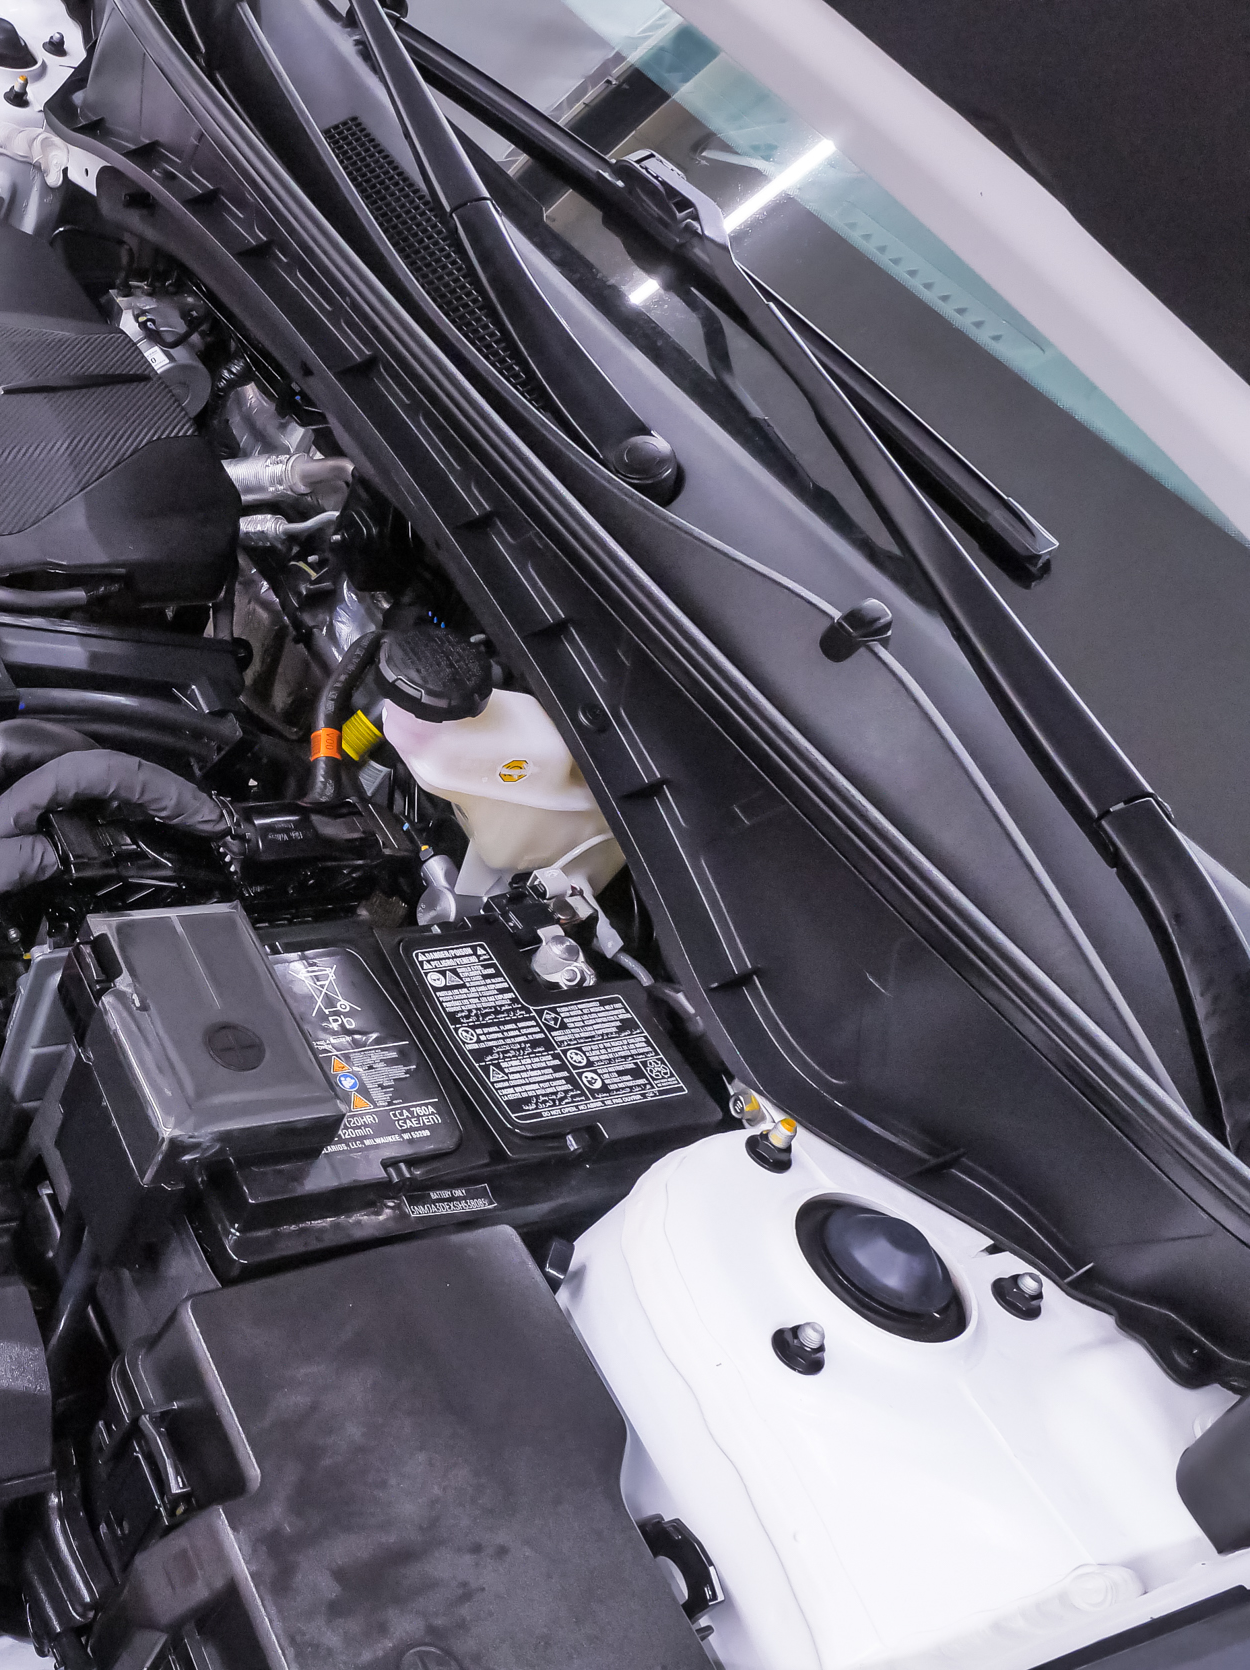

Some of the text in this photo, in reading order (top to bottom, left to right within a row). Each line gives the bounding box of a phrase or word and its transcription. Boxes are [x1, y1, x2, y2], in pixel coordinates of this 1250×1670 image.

[328, 1015, 356, 1031] Pb
[389, 1109, 411, 1120] CCA
[410, 1105, 437, 1118] 760A
